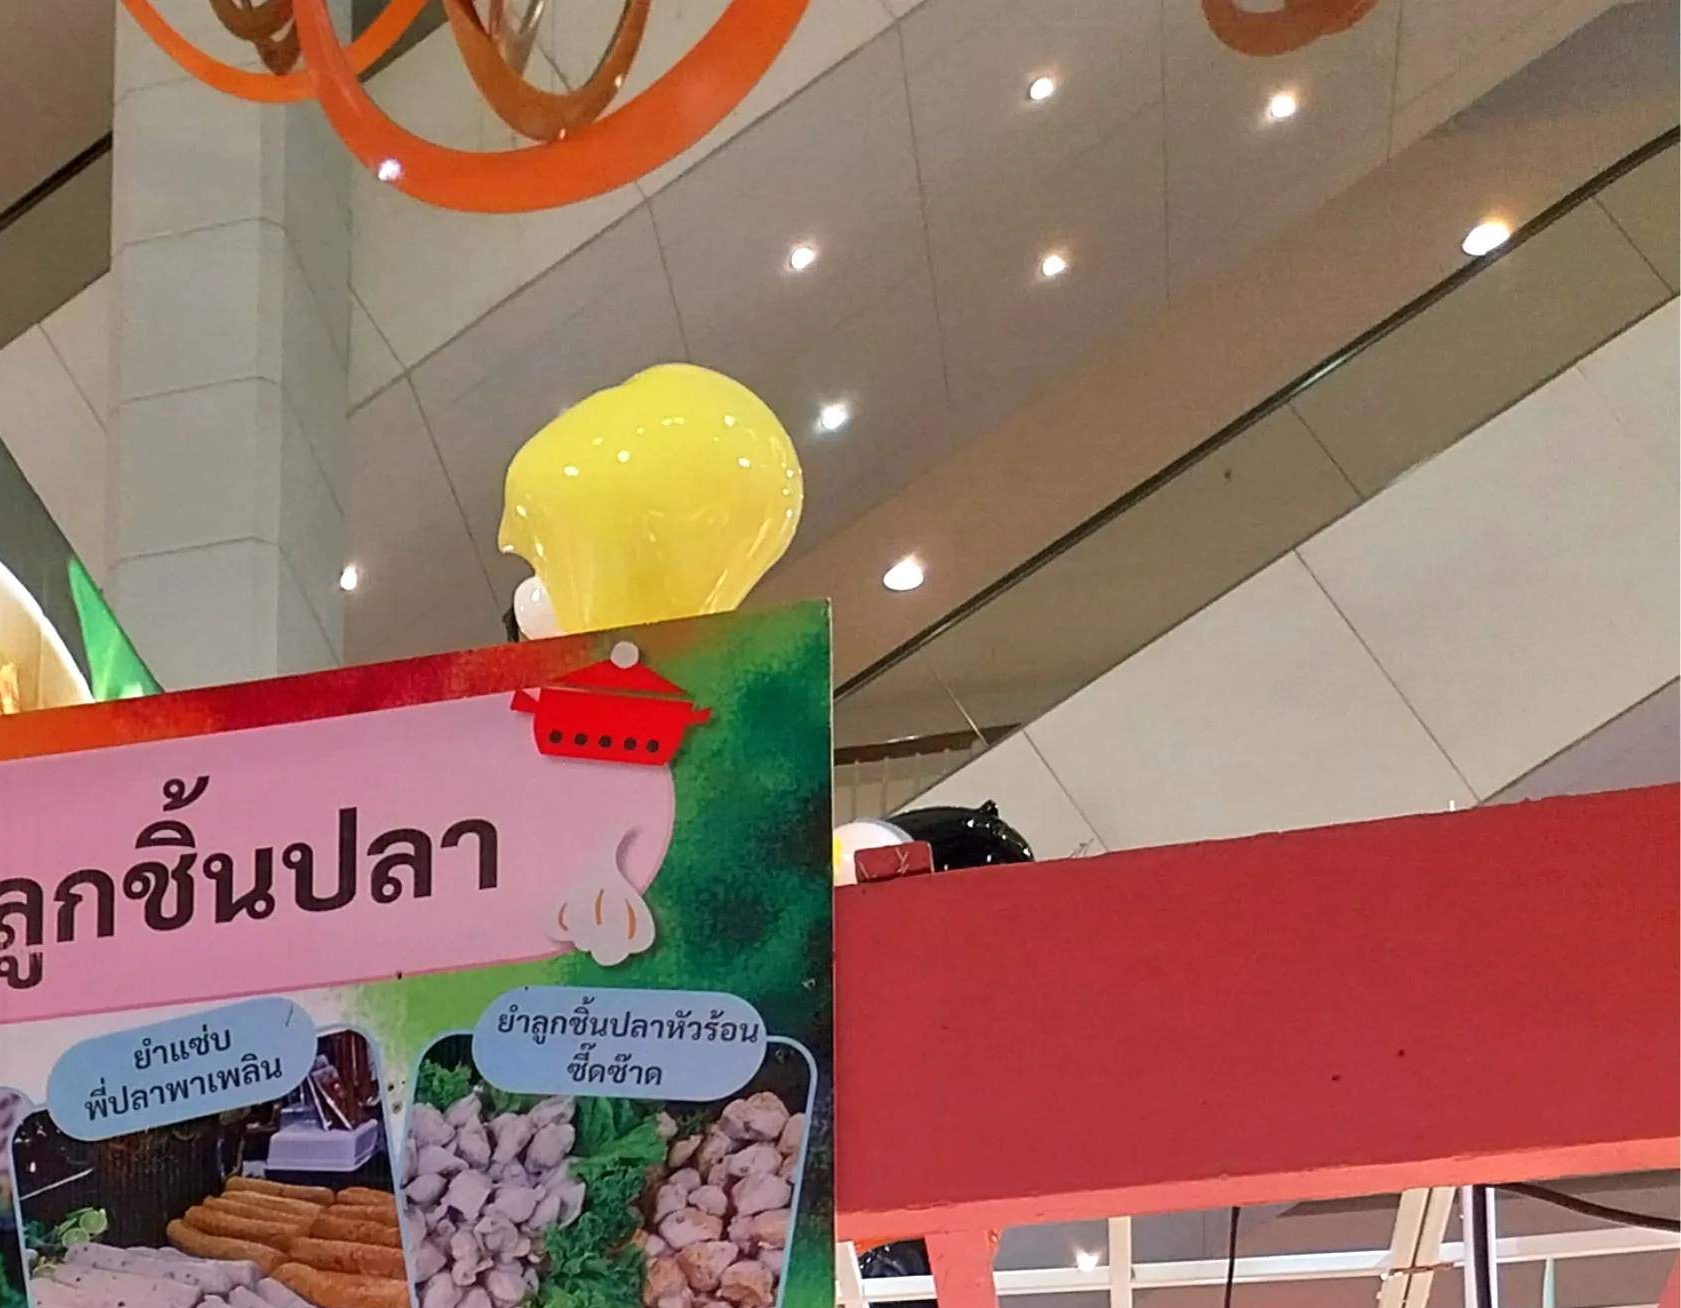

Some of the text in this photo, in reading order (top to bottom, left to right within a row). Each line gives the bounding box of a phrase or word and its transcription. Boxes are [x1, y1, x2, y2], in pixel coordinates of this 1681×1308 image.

[497, 997, 759, 1045] ยำลูกชิ้นปลาหัวร้อน
[134, 1024, 232, 1071] ยำแซ่บ
[567, 1042, 663, 1085] ซี๊ดซ๊าด
[84, 1054, 283, 1122] พี่ปลาพาเพลิน
